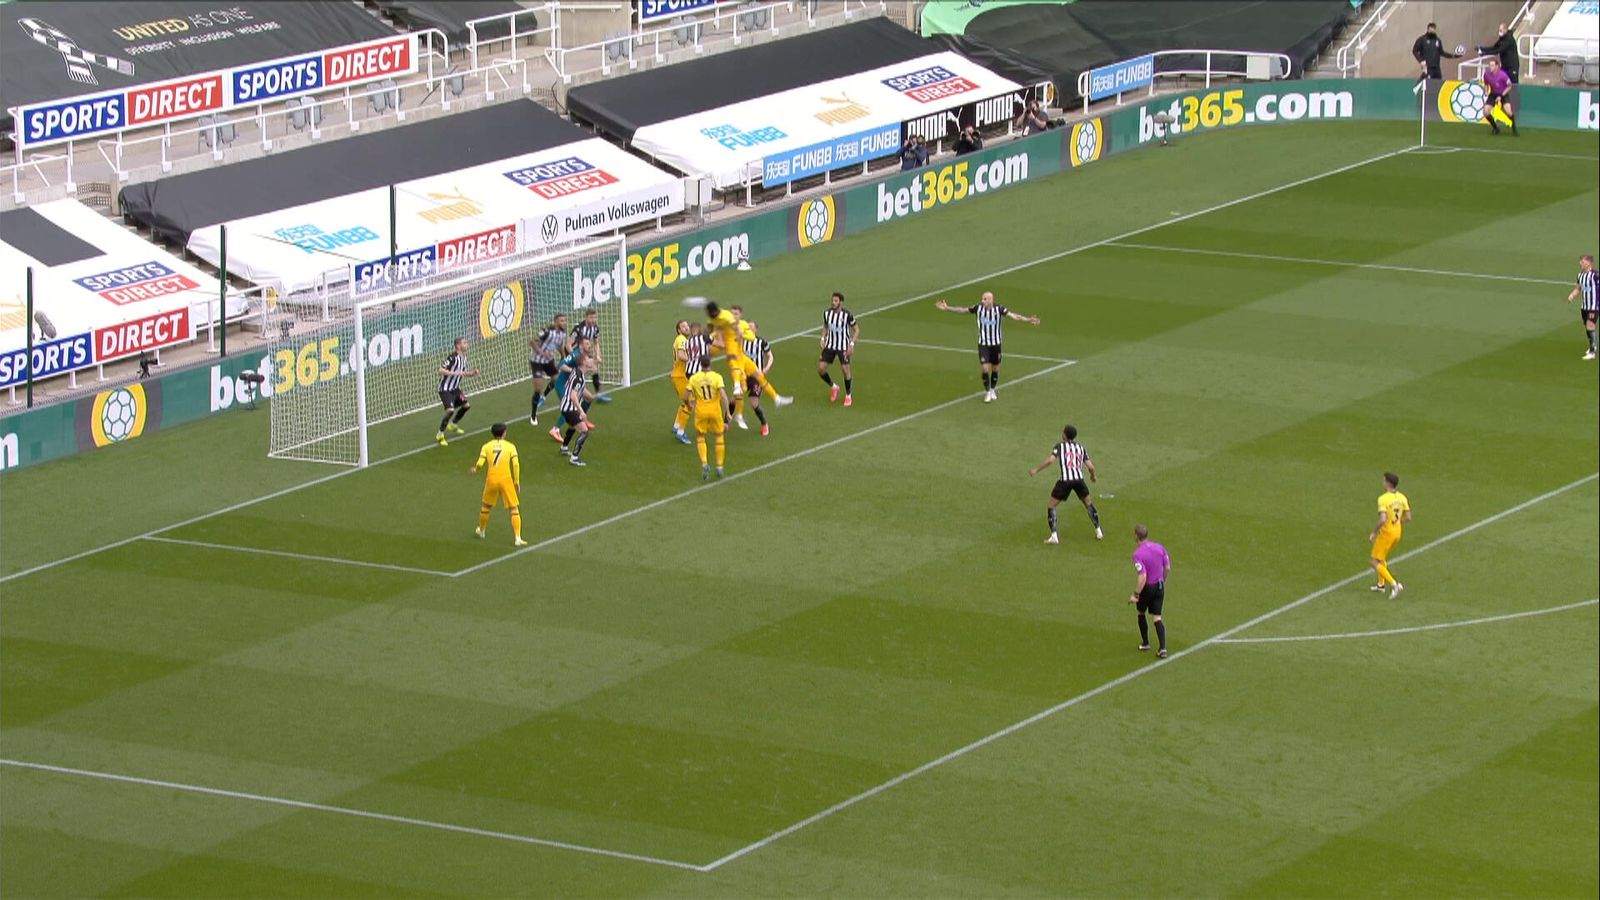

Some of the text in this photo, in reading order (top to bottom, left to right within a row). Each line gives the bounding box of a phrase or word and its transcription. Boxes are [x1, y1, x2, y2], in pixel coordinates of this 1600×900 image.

[112, 6, 253, 41] UNITED AS ONE
[887, 66, 951, 91] SPORTS
[1115, 61, 1152, 88] FUN88
[30, 44, 405, 139] SPORTS DIRECT SPORTS DIRECT
[912, 79, 973, 103] DIRECT
[907, 93, 1014, 141] PUMA PUMA
[1138, 90, 1354, 143] bet365.com
[718, 126, 788, 151] FUN88
[792, 146, 832, 175] FUN88
[860, 128, 899, 155] FUN88
[512, 158, 587, 186] SPORTS
[538, 171, 610, 199] DIRECT
[876, 152, 1029, 222] bet365.com
[564, 194, 670, 233] Pulman Volkswagen
[293, 227, 380, 254] FUN88
[360, 229, 514, 291] SPORTS DIRECT
[83, 262, 168, 291] SPORTS
[110, 278, 190, 304] DIRECT
[0, 312, 183, 382] SPORTS DIRECT
[701, 384, 712, 400] 11
[492, 449, 502, 466] 7
